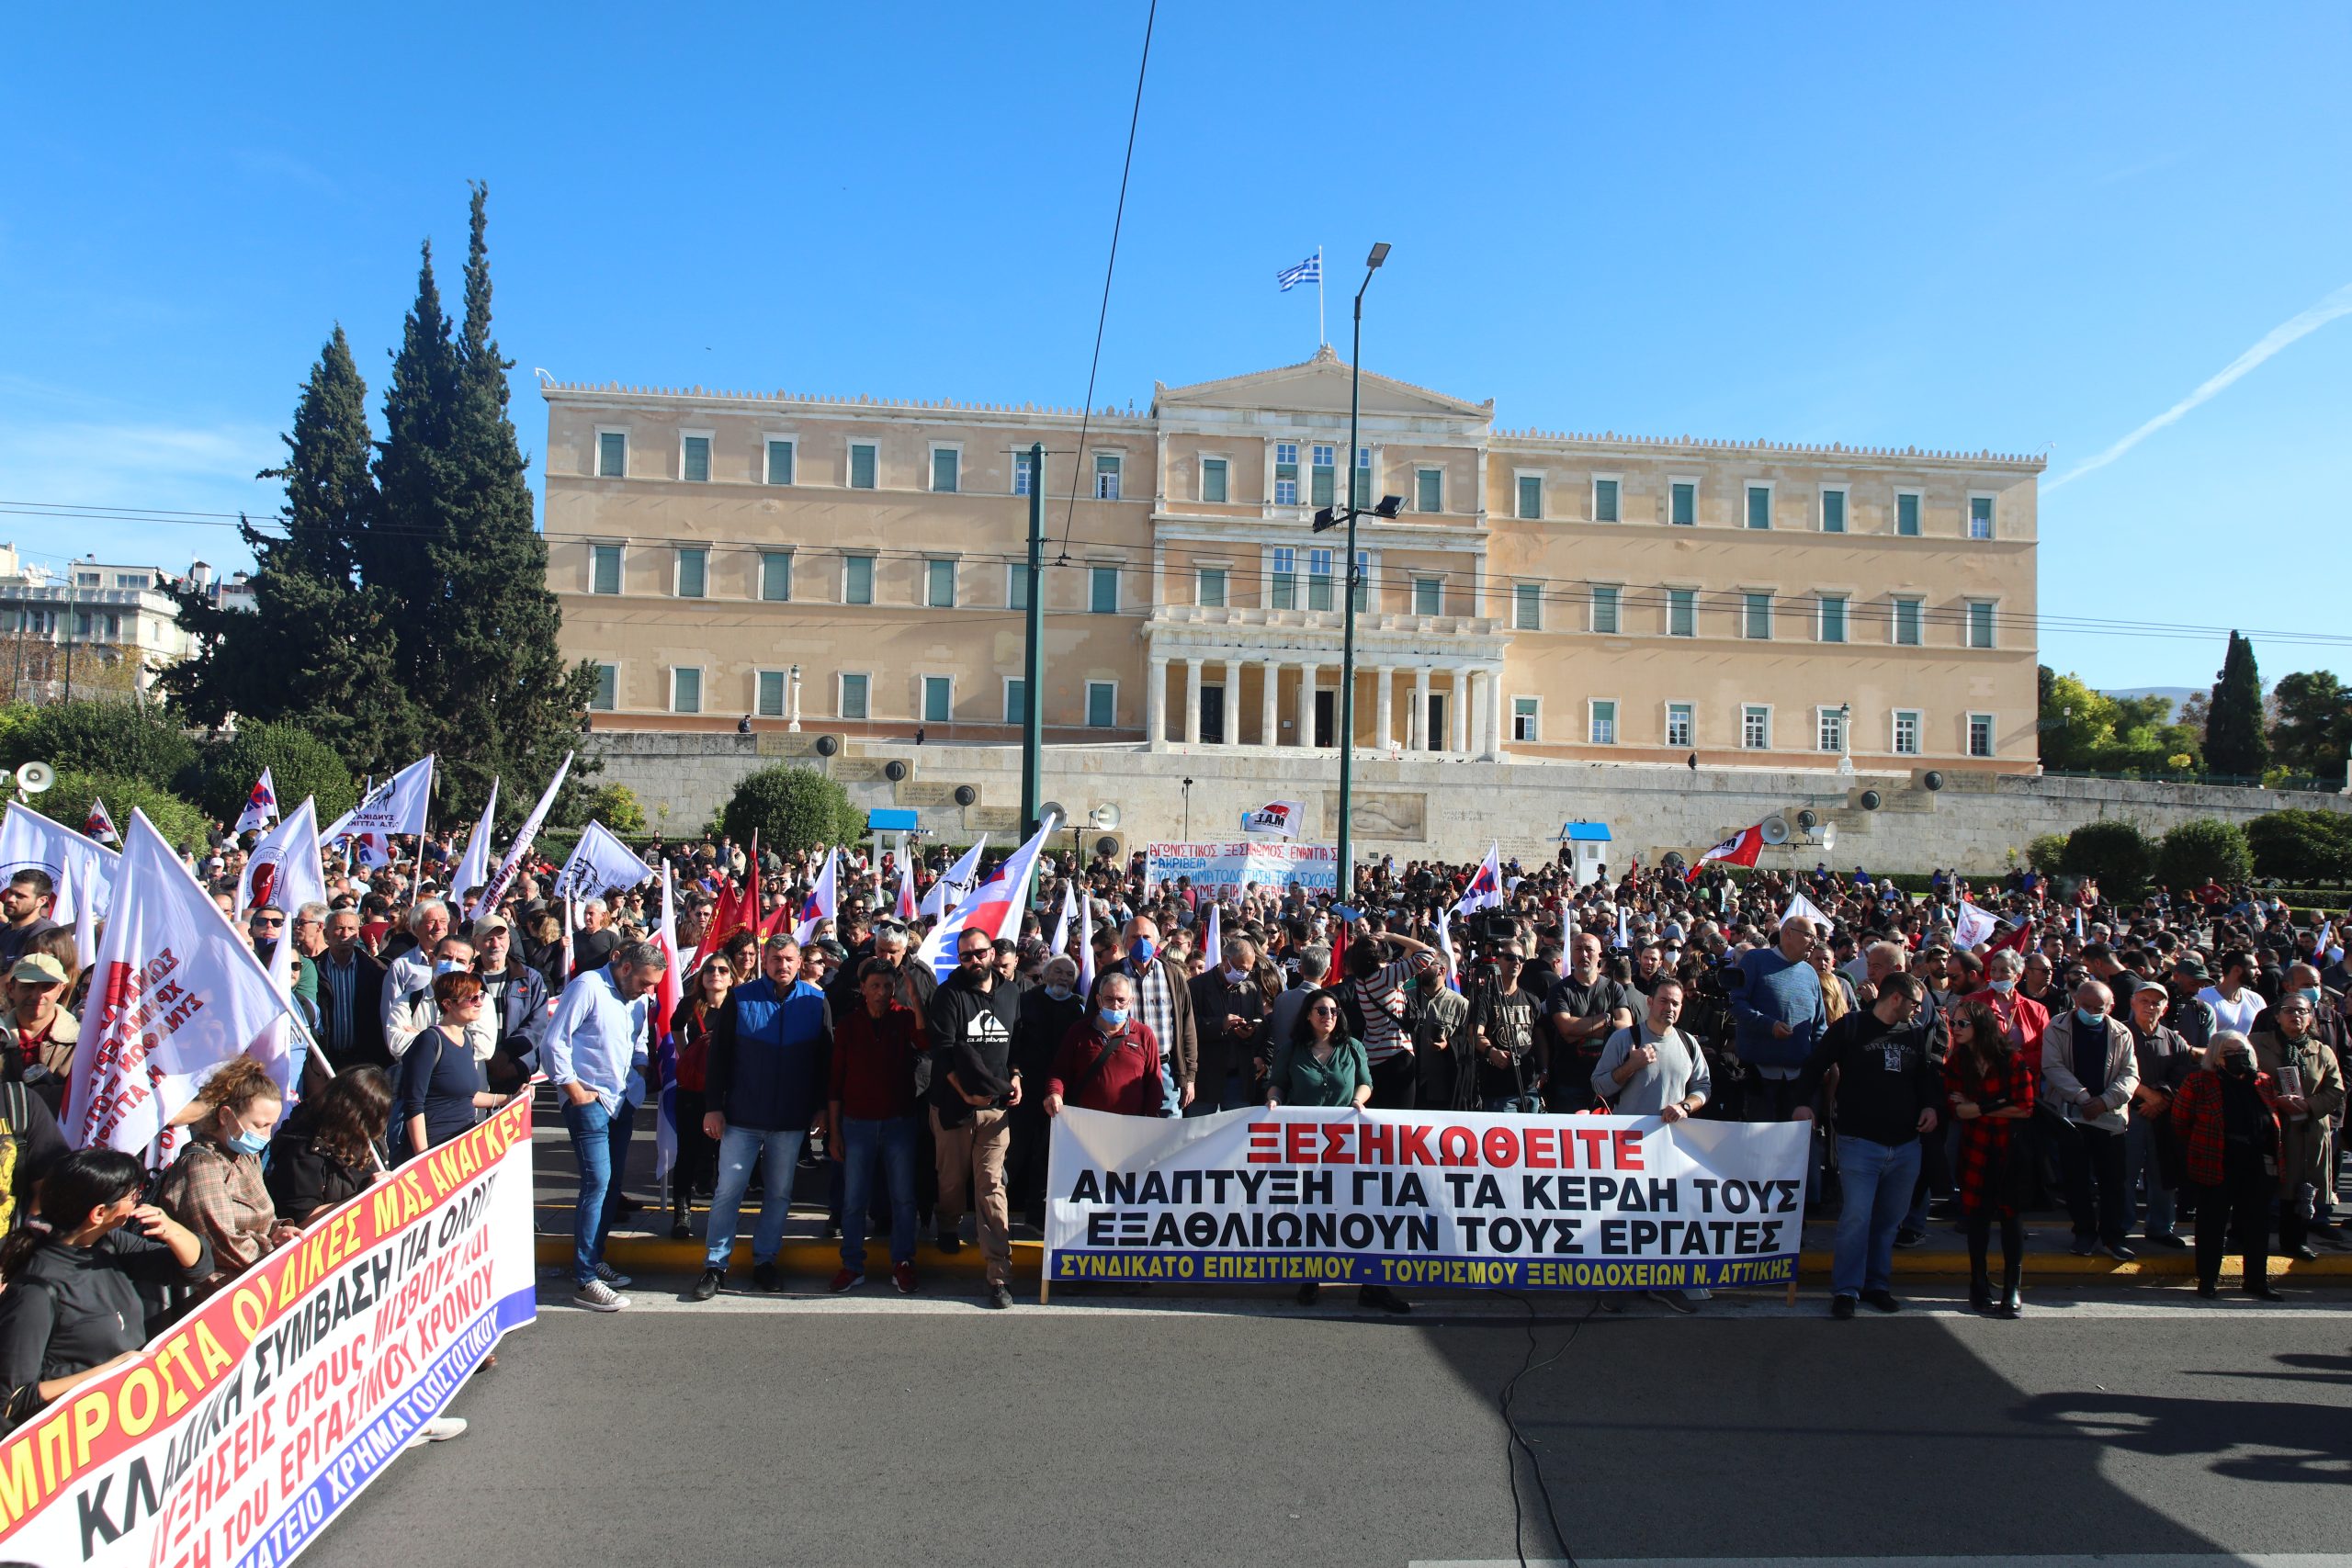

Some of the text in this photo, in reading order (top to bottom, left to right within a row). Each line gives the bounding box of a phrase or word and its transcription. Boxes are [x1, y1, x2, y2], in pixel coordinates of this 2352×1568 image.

[1149, 843, 1339, 861] ΑΓΩΝΙΣΤΙΚΟΣ ΞΕΣΗΚΩΜΟΣ ΕΝΑΝΤΙΑ Σ
[1300, 872, 1337, 887] ΣΧΟΛΩ
[1247, 1122, 1645, 1170] ΞΕΣΗΚΩΘΕΙΤΕ
[277, 1203, 364, 1312] ΔΙΚΕΣ
[373, 1173, 434, 1238] ΜΑΣ
[427, 1101, 525, 1198] ΑΝΑΓΚΕΣ
[1069, 1169, 1801, 1213] ΑΝΑΠΤΥΞΗ ΓΙΑ ΤΑ ΚΕΡΔΗ ΤΟΥΣ
[1087, 1211, 1784, 1256] ΕΞΑΘΛΙΩΝΟΥΝ ΤΟΥΣ ΕΡΓΑΤΕΣ
[1060, 1254, 1194, 1278] ΣΥΝΔΙΚΑΤΟ
[1204, 1256, 1355, 1280] ΕΠΙΣΙΤΙΣΜΟΥ
[1381, 1258, 1519, 1285] ΤΟΥΡΙΣΜΟΥ
[1526, 1262, 1686, 1287] ΞΕΝΟΔΟΧΕΙΩΝ
[1693, 1264, 1712, 1285] Ν.
[1717, 1258, 1793, 1284] ΑΤΤΙΚΗΣ
[254, 1247, 393, 1401] ΣΥΜΒΑΣΗ
[396, 1221, 432, 1283] ΓΙΑ
[280, 1328, 417, 1500] ΕΡΓΑΣΙΜΟΥ
[416, 1258, 494, 1361] ΧΡΟΝΟΥ
